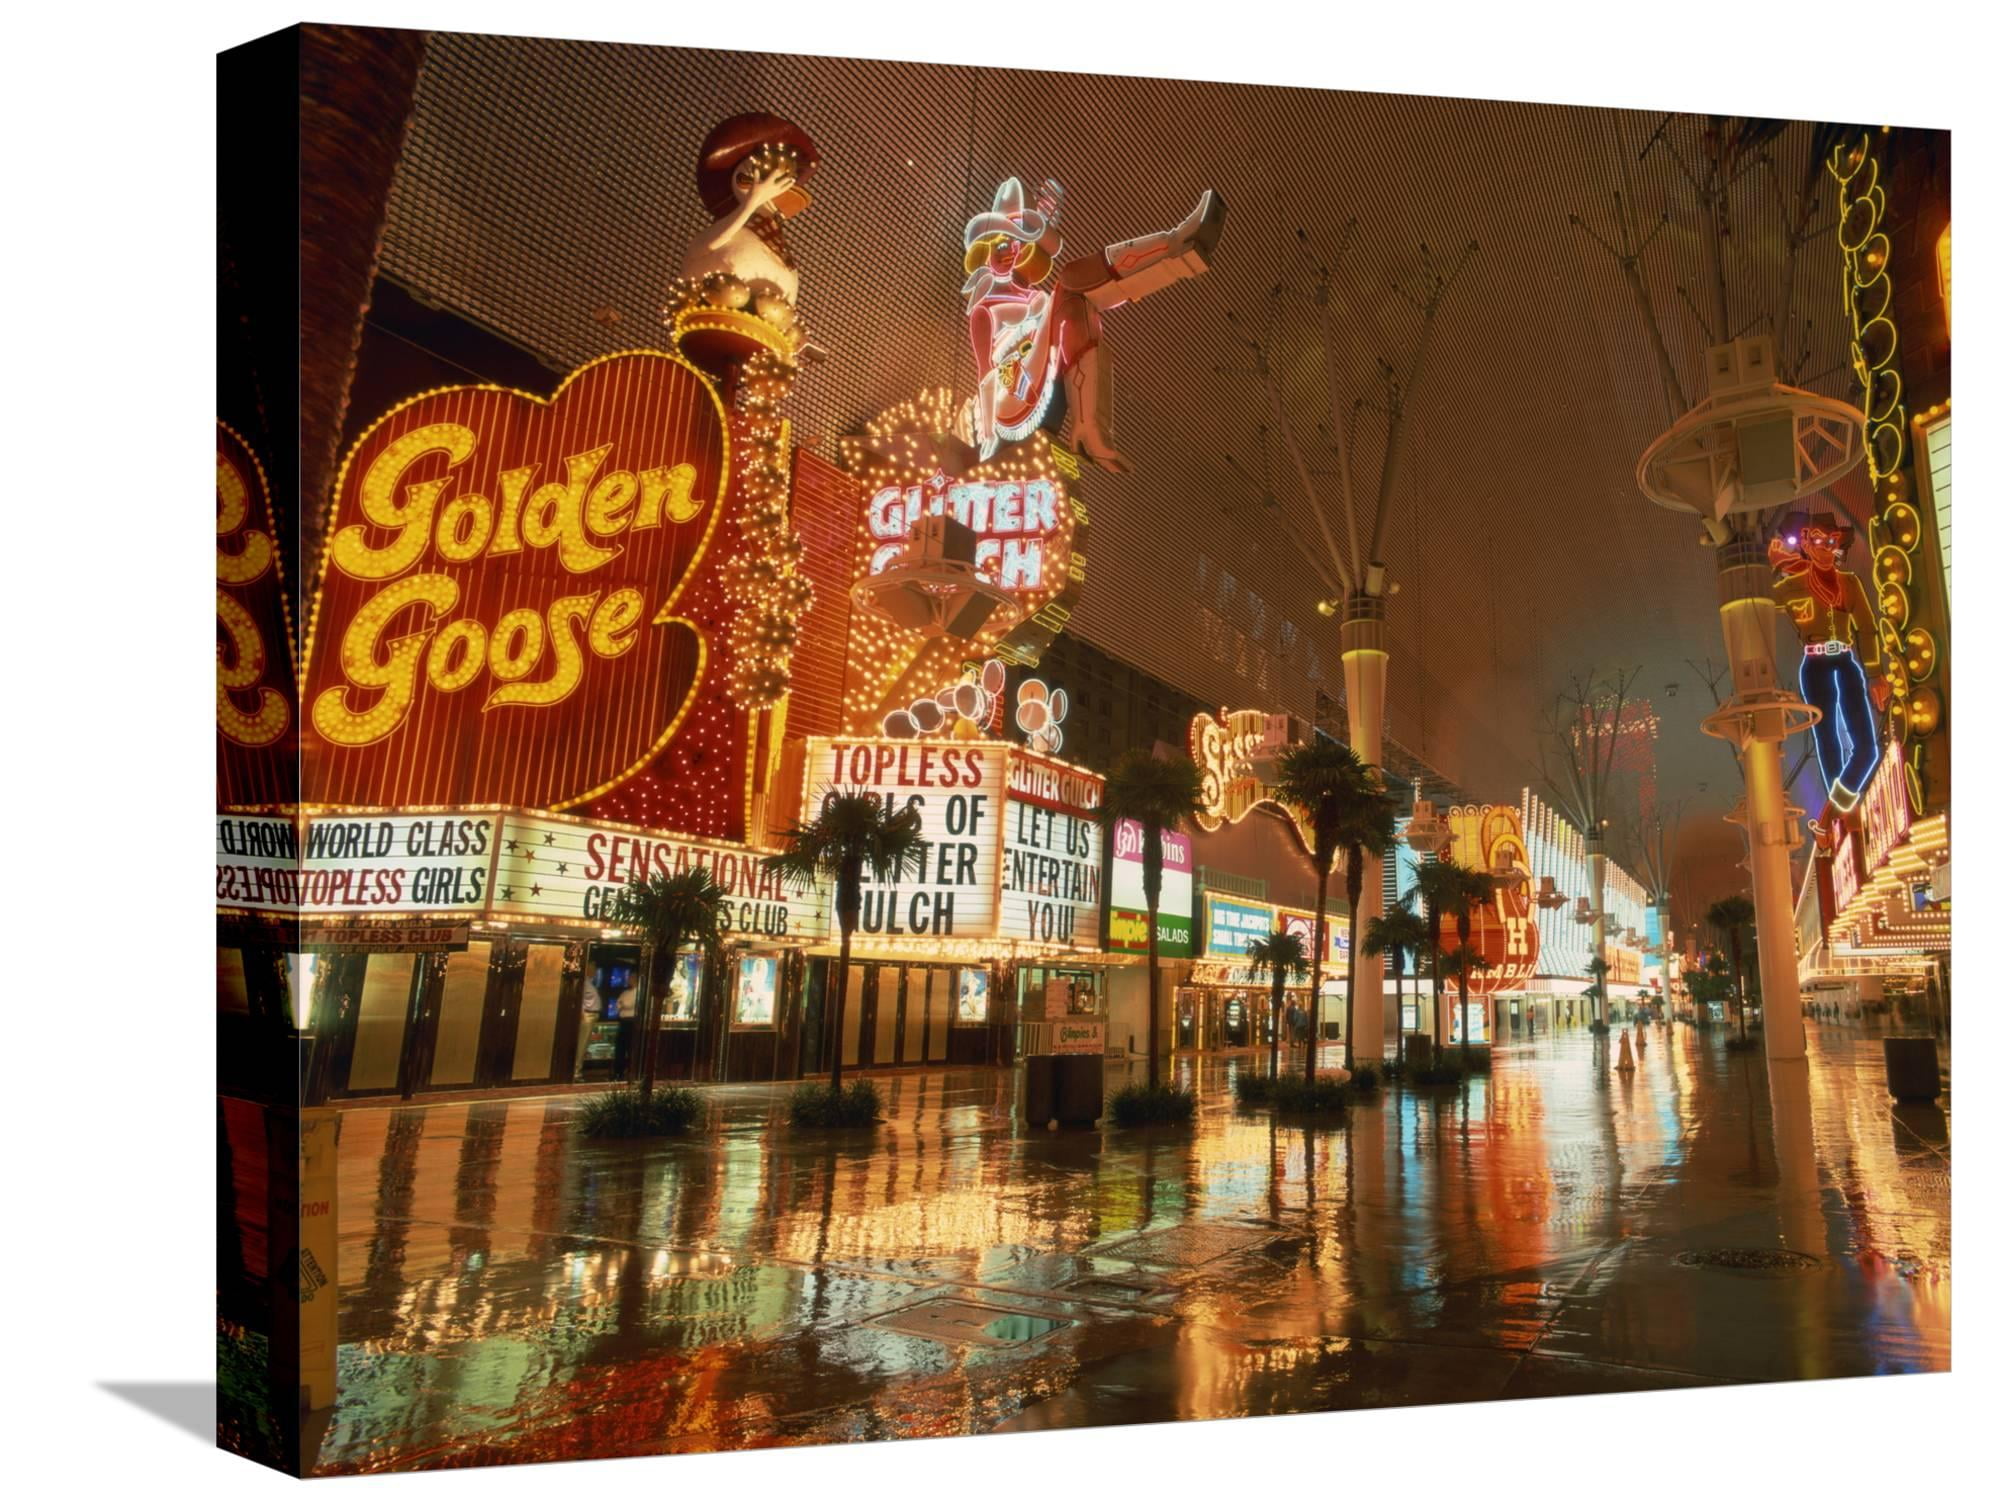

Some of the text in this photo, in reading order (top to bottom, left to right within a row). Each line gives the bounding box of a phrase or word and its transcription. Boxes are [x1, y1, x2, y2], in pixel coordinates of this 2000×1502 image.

[332, 423, 704, 580] Golden
[312, 573, 643, 747] Goose
[831, 743, 984, 789] TOPLESS
[1009, 756, 1101, 810] GLITTER GULCH
[945, 794, 988, 836] OF
[1017, 802, 1091, 859] LET US
[305, 819, 491, 859] WORLD CLASS
[300, 866, 486, 906] TOPLESS GIRLS
[583, 832, 787, 902] SENSATIONAL
[1003, 847, 1100, 905] ENTERTAIN
[738, 901, 788, 936] CLUB
[855, 889, 954, 936] ULCH
[1027, 899, 1075, 946] YOU!
[324, 929, 402, 944] TOPLESS
[407, 928, 453, 942] CLUB
[1156, 927, 1189, 945] SALADS
[1506, 917, 1528, 955] H
